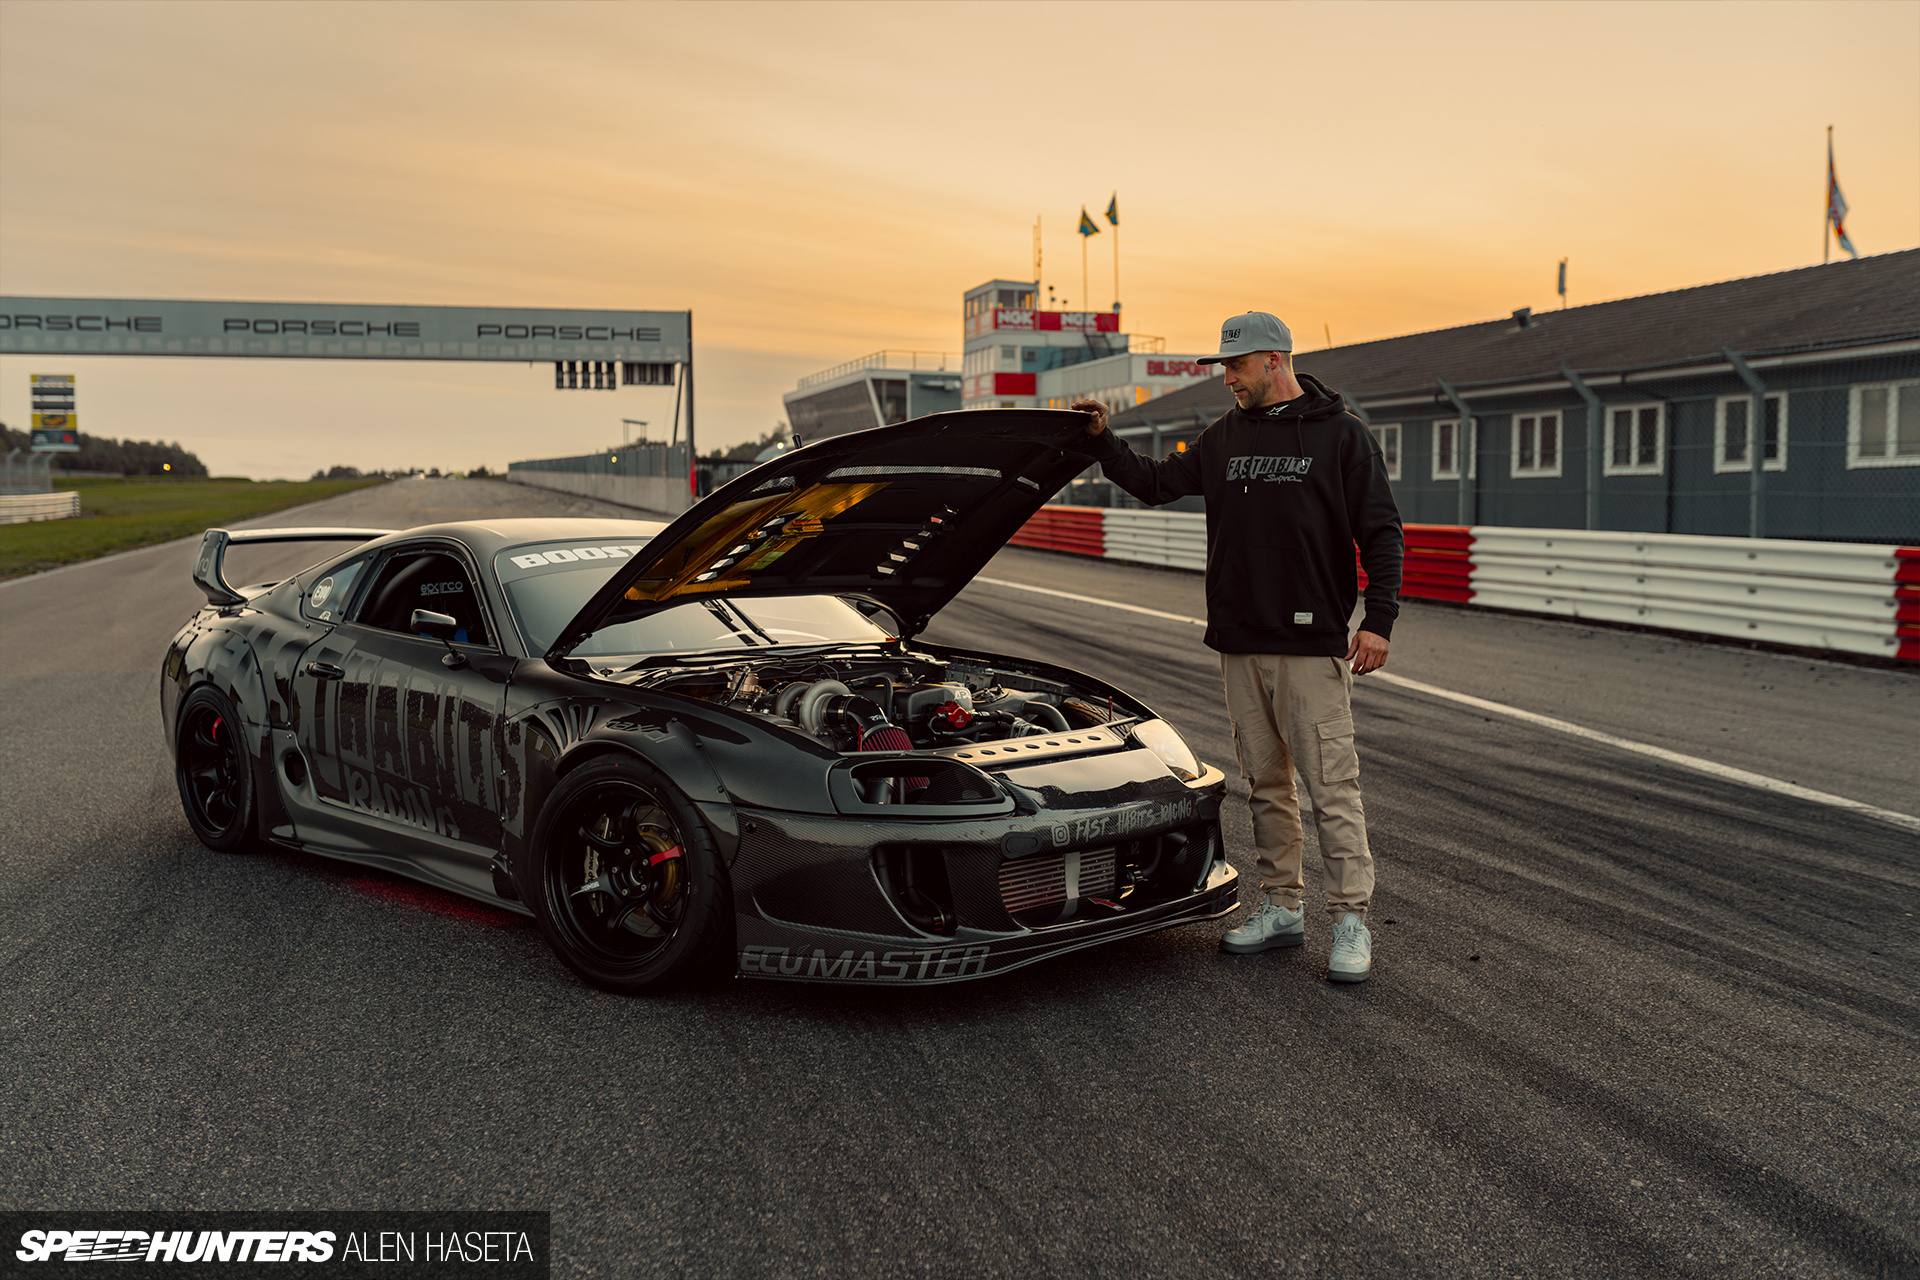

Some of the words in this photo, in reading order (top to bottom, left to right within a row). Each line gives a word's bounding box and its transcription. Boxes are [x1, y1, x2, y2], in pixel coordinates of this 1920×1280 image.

[997, 311, 1034, 325] NGK
[1061, 313, 1098, 326] NGK
[223, 318, 420, 337] PORSCHE
[477, 324, 661, 341] PORSCHE
[344, 764, 461, 840] RACING
